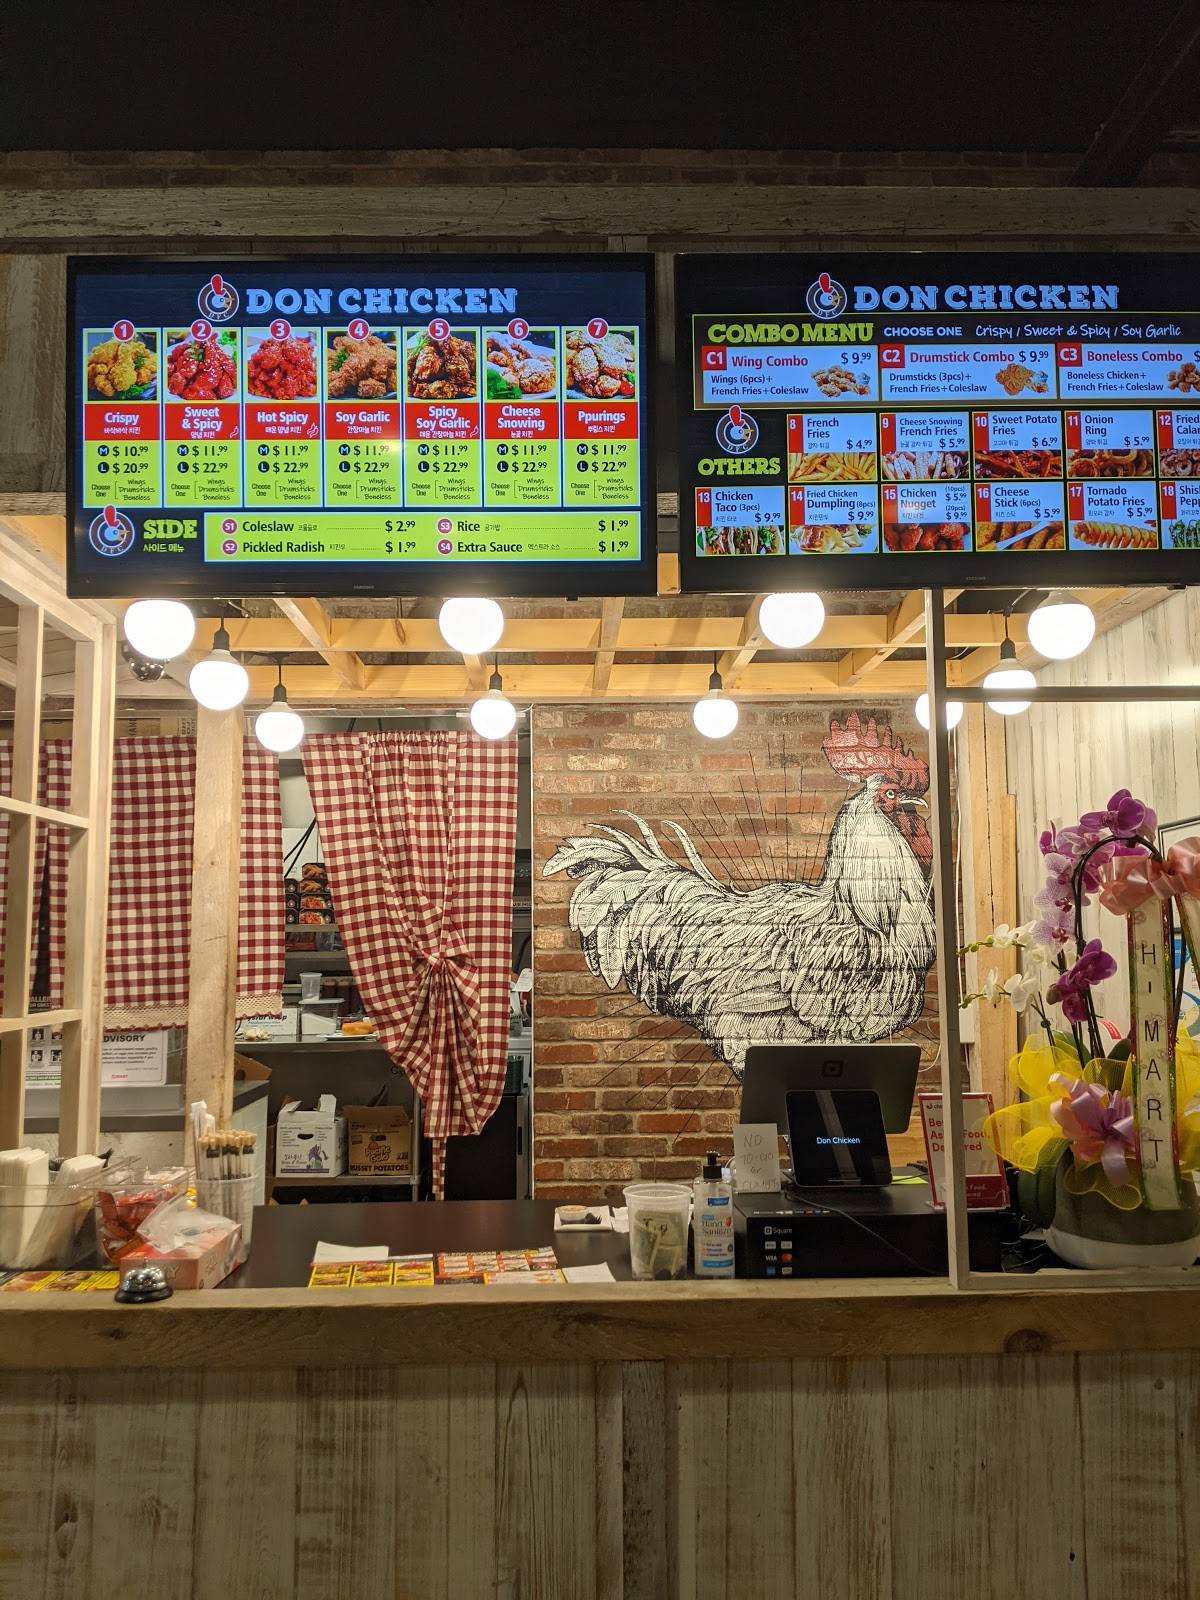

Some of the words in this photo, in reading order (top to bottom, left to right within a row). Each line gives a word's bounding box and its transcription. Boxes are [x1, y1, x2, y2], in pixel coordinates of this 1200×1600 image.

[246, 288, 332, 314] DON
[338, 288, 517, 314] CHICKEN
[854, 285, 937, 311] DON
[944, 284, 1119, 310] CHICKEN
[707, 323, 799, 343] COMBO
[801, 322, 874, 342] MENU
[883, 327, 934, 337] CHOOSE
[938, 327, 962, 336] ONE
[975, 325, 1014, 339] Crispy
[1024, 324, 1063, 337] Sweet
[1066, 325, 1077, 336] &
[1080, 324, 1110, 339] Spicy
[1121, 324, 1142, 339] Soy
[1145, 324, 1182, 337] Garlic
[706, 351, 723, 365] C1
[731, 356, 762, 369] Wing
[766, 355, 808, 367] Combo
[882, 350, 900, 363] C2
[910, 351, 969, 363] Drumstick
[972, 351, 1014, 362] Combo
[1060, 348, 1078, 361] C3
[1087, 351, 1138, 362] Boneless
[1141, 351, 1183, 362] Combo
[711, 375, 738, 384] Wings
[889, 373, 936, 381] Drumsticks
[1067, 371, 1105, 380] Boneless
[185, 406, 219, 418] Sweet
[428, 406, 458, 419] Spicy
[501, 405, 540, 417] Cheese
[104, 412, 139, 425] Crispy
[257, 412, 277, 422] Hot
[279, 411, 308, 424] Spicy
[335, 411, 356, 424] Soy
[358, 411, 390, 422] Garlic
[578, 411, 626, 424] Ppurings
[882, 418, 889, 429] 9
[900, 418, 927, 426] Cheese
[929, 418, 963, 426] Snowing
[975, 416, 987, 426] 10
[993, 415, 1023, 424] Sweet
[1025, 414, 1058, 424] Potato
[1067, 415, 1079, 426] 11
[1084, 414, 1114, 424] Onion
[1160, 415, 1171, 426] 12
[1176, 414, 1200, 424] Fried
[182, 419, 191, 429] &
[193, 419, 222, 431] Spicy
[416, 418, 436, 431] Soy
[439, 417, 470, 428] Garlic
[497, 417, 545, 431] Snowing
[790, 419, 796, 430] 8
[807, 418, 839, 428] French
[807, 429, 830, 438] Fries
[900, 426, 932, 436] French
[934, 426, 958, 436] Fries
[993, 426, 1016, 435] Fries
[1085, 425, 1107, 436] Ring
[697, 457, 781, 476] OTHERS
[791, 491, 803, 501] 14
[806, 490, 825, 498] Fried
[828, 490, 858, 498] Chicken
[884, 489, 896, 499] 15
[900, 488, 937, 498] Chicken
[977, 488, 989, 498] 16
[994, 487, 1029, 497] Cheese
[1069, 487, 1081, 497] 17
[1087, 486, 1127, 495] Tornado
[1162, 486, 1174, 496] 18
[1179, 485, 1200, 495] Shis
[698, 492, 710, 503] 13
[715, 491, 753, 501] Chicken
[995, 498, 1018, 508] Stick
[1020, 499, 1041, 508] (6pcs)
[1087, 497, 1120, 506] Potato
[1122, 496, 1145, 506] Fries
[715, 503, 737, 512] Taco
[739, 503, 760, 513] (3pcs)
[807, 499, 855, 510] Dumpling
[900, 499, 936, 509] Nugget
[143, 519, 198, 539] SIDE
[242, 520, 294, 532] Coleslaw
[457, 520, 480, 531] Rice
[143, 543, 167, 553] 사이드
[168, 543, 184, 553] 메뉴
[243, 541, 283, 553] Pickled
[286, 541, 325, 553] Radish
[457, 541, 486, 553] Extra
[489, 541, 523, 553] Sauce
[103, 1034, 145, 1043] DVISORY
[832, 1136, 861, 1144] Chicken
